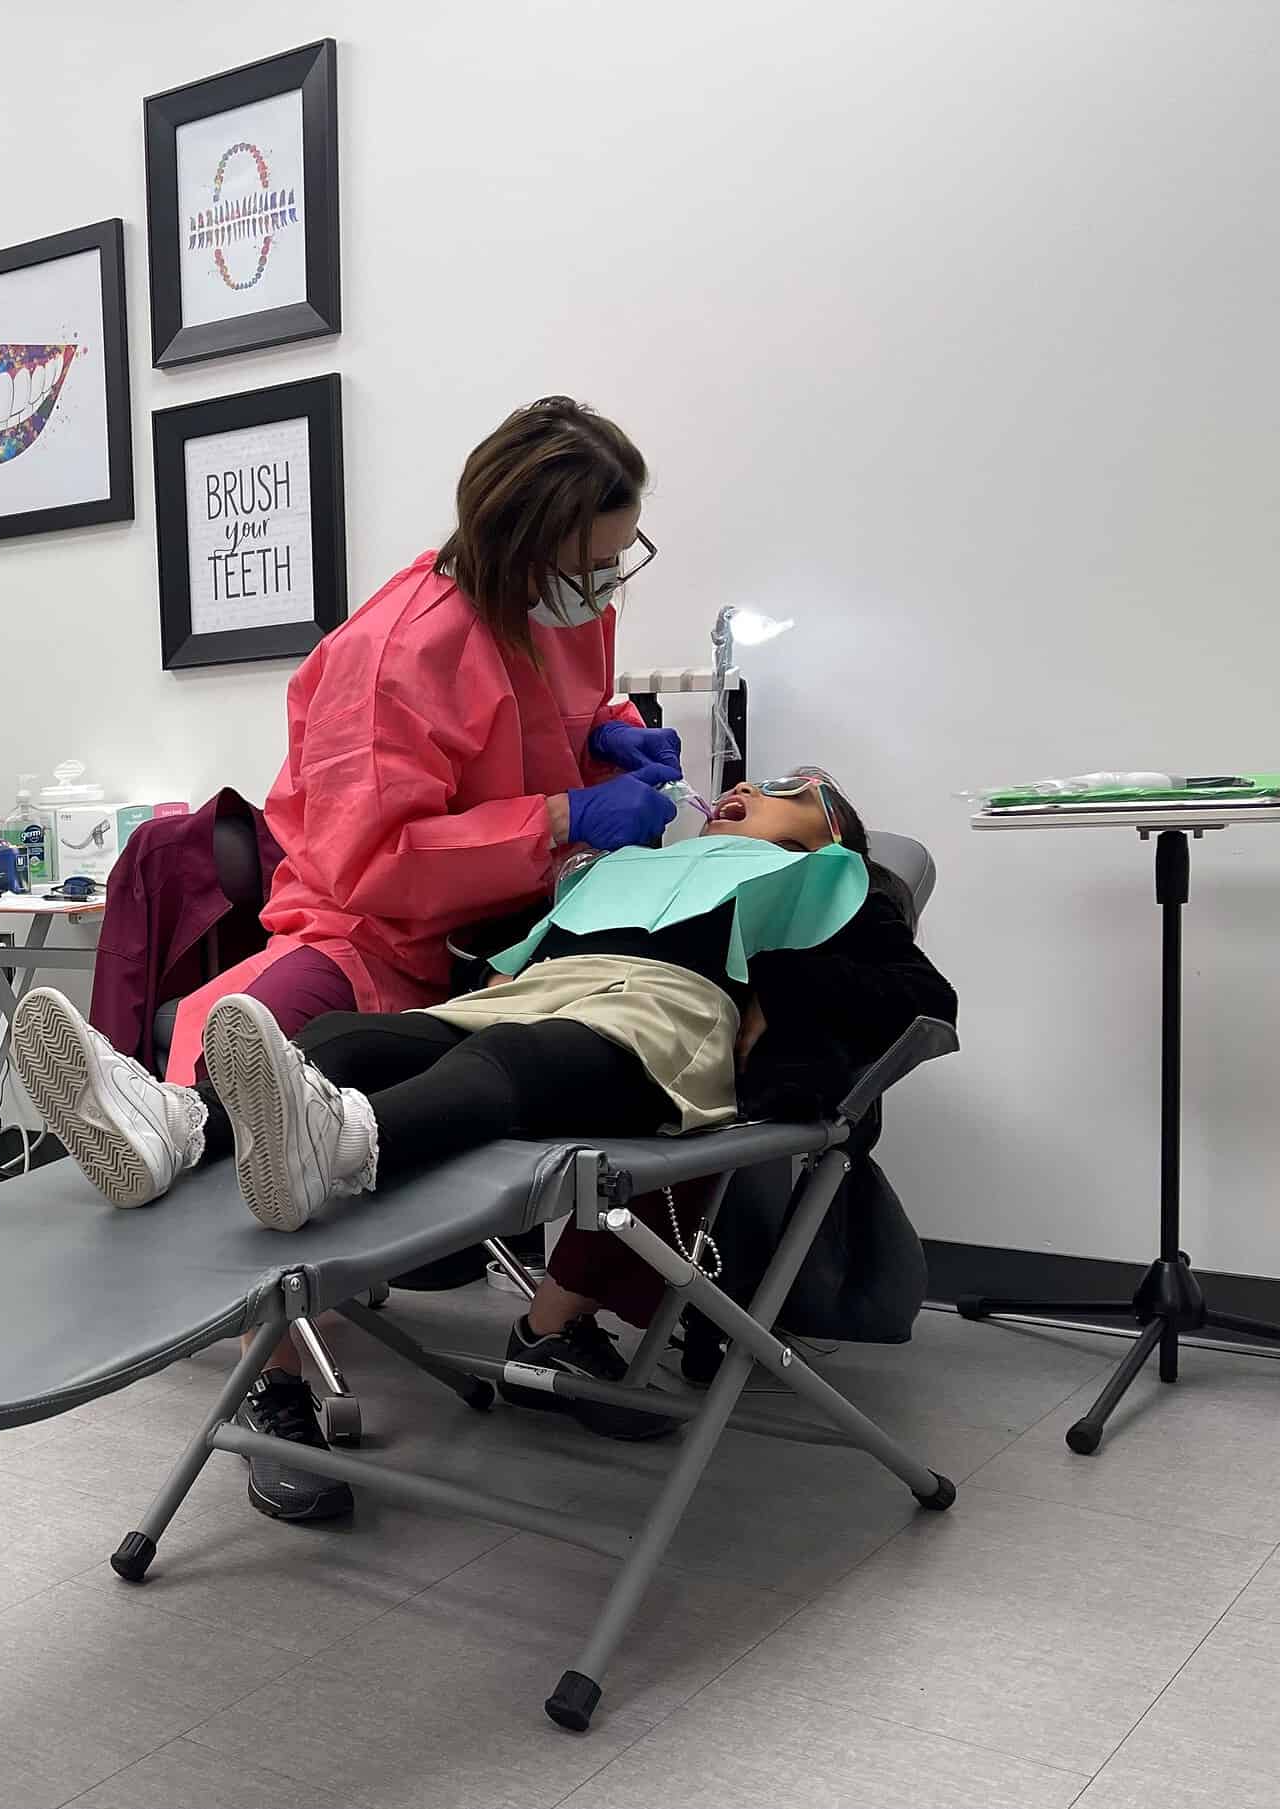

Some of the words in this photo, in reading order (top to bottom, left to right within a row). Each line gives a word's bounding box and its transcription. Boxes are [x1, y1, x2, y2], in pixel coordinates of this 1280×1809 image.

[206, 461, 291, 520] BRUSH
[213, 516, 271, 560] your
[207, 545, 292, 601] TEETH
